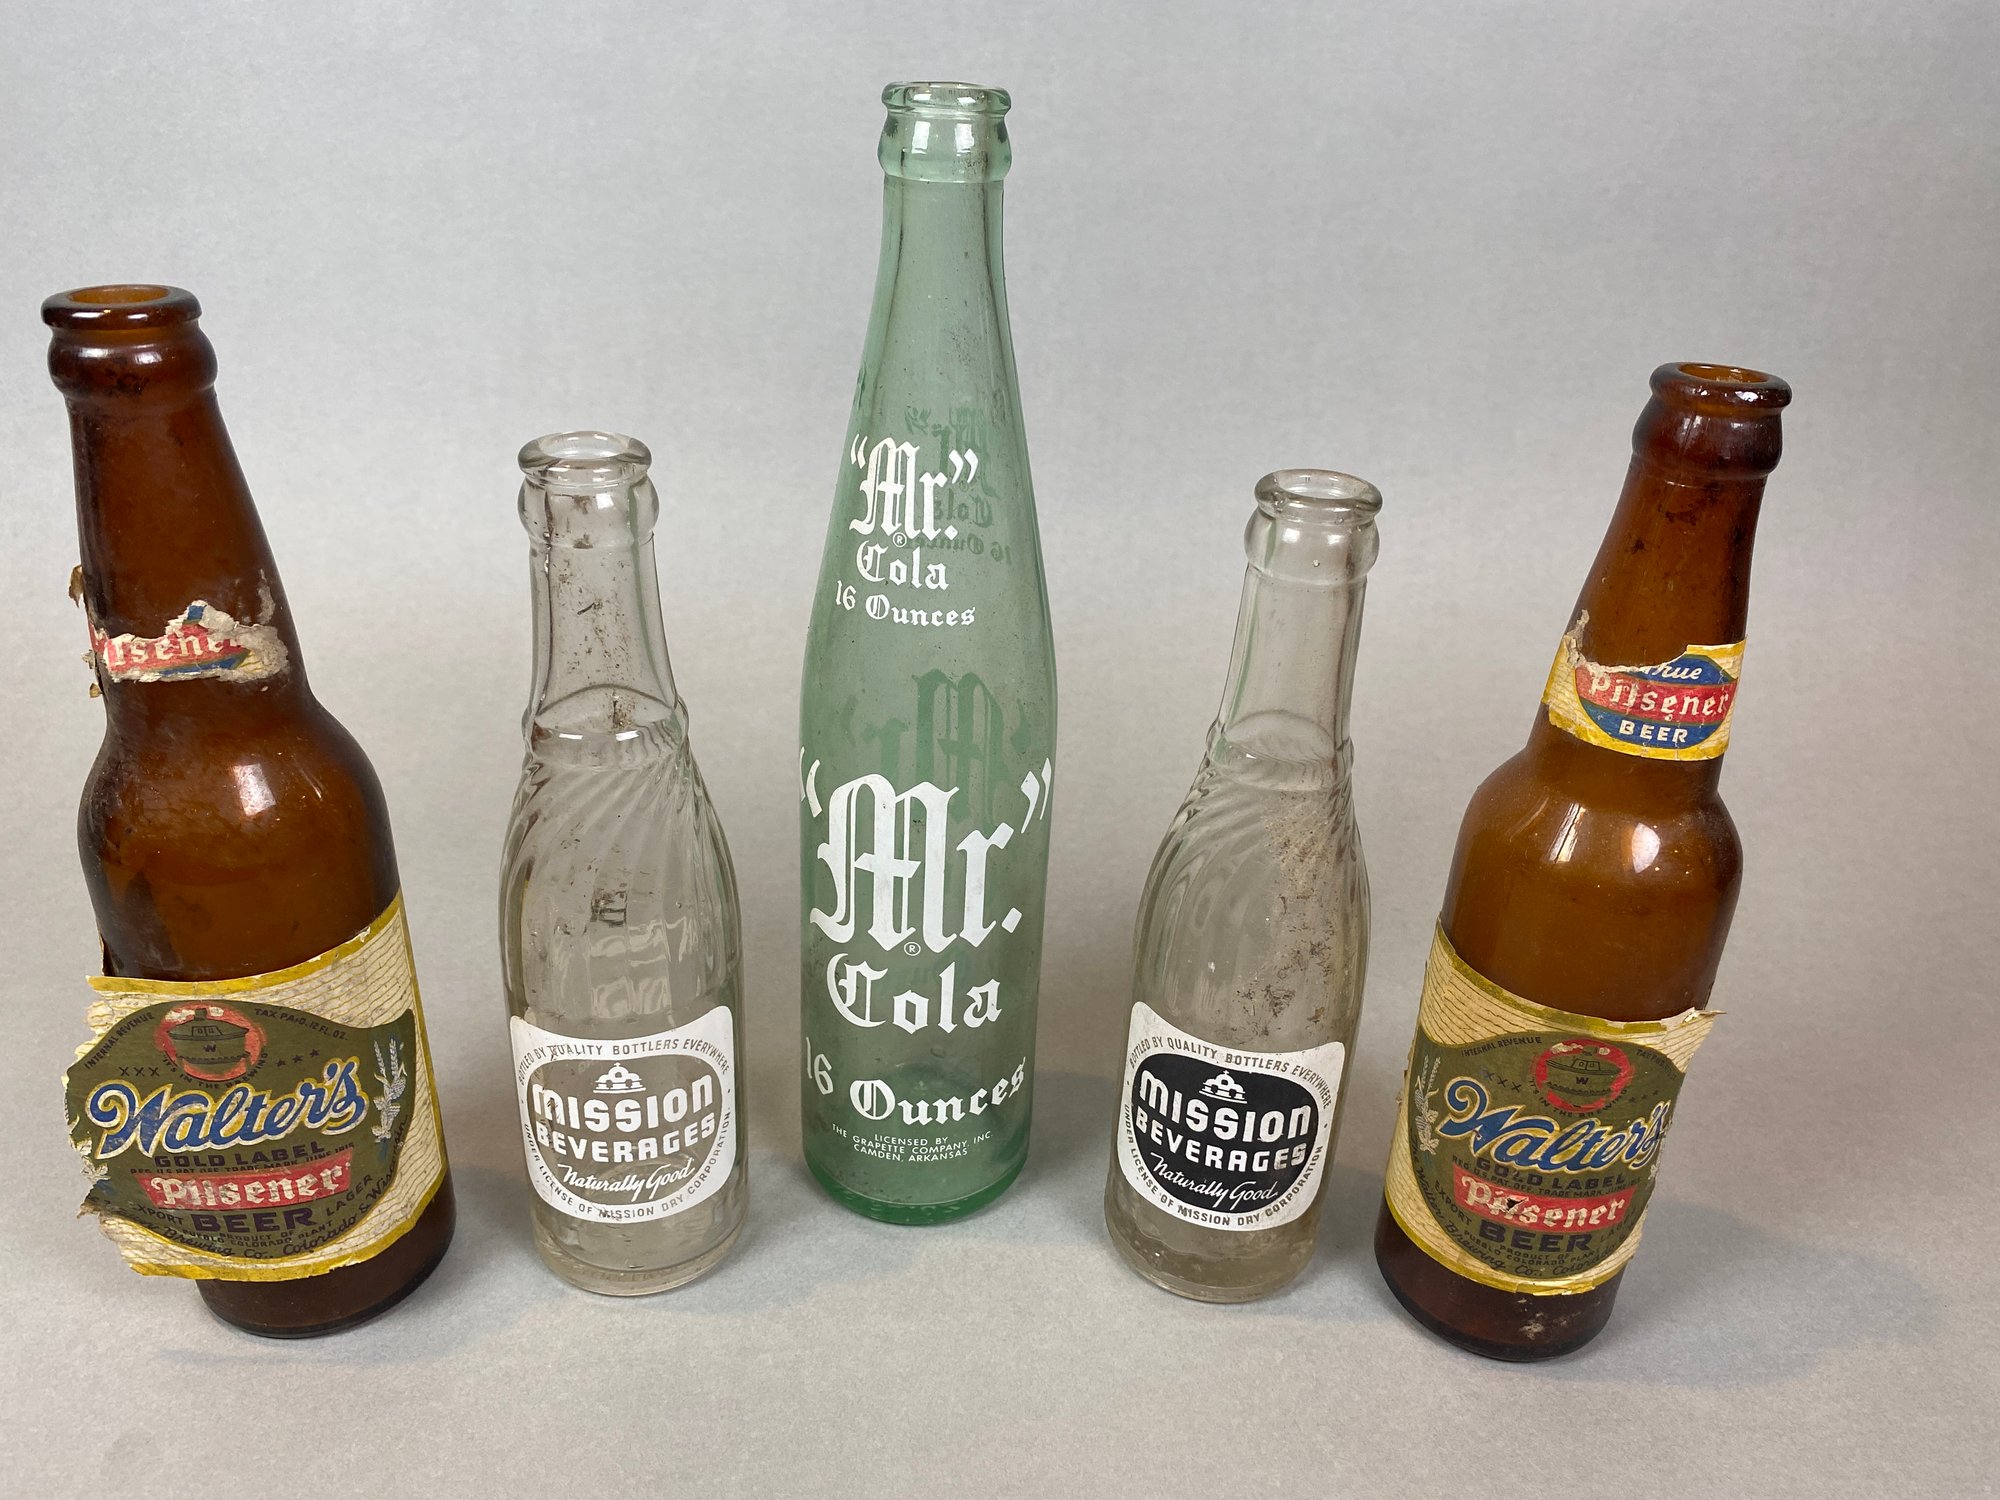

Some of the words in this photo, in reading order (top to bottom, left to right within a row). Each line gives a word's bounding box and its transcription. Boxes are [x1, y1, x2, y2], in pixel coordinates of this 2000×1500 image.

[856, 540, 949, 591] Cola
[835, 580, 857, 611] 16
[865, 594, 976, 627] Ounces
[1588, 670, 1728, 717] Pilsener
[1618, 719, 1688, 744] BEER
[254, 1008, 277, 1020] TAX
[826, 953, 1002, 1035] Cola
[83, 1031, 119, 1070] INTERNAL
[116, 1012, 155, 1037] REVENUE
[533, 1046, 547, 1060] BY
[612, 1039, 679, 1056] BOTTLERS
[682, 1038, 730, 1076] EVERYWHERE
[1461, 1043, 1496, 1057] INTERNAL
[1498, 1036, 1542, 1049] REVENUE
[805, 1036, 834, 1095] 16
[849, 1056, 1027, 1126] Ounces
[1130, 1038, 1151, 1069] BOTTLED
[1152, 1036, 1164, 1048] BY
[1167, 1037, 1217, 1060] QUALITY
[1225, 1053, 1290, 1073] BOTTLERS
[1291, 1065, 1333, 1109] EVERYWHERE
[85, 1055, 370, 1159] Walter's
[154, 1153, 226, 1168] GOLD
[235, 1140, 325, 1165] LABEL
[535, 1112, 716, 1163] BEVERAGES
[832, 1123, 848, 1138] THE
[852, 1135, 905, 1154] GRAPETTE
[973, 1130, 993, 1144] INC.
[874, 1134, 928, 1146] LICENSED
[935, 1136, 948, 1145] BY
[908, 1148, 968, 1162] ARKANSAS
[1136, 1103, 1307, 1173] BEVERAGES
[151, 1163, 345, 1207] Pilsener
[524, 1123, 540, 1162] UNDER
[539, 1164, 574, 1206] LICENSE
[578, 1203, 593, 1213] OF
[598, 1206, 655, 1220] MISSION
[662, 1195, 684, 1213] DRY
[557, 1163, 647, 1203] Naturally
[646, 1158, 696, 1200] Good
[1124, 1103, 1134, 1144] UNDER
[1130, 1148, 1158, 1195] LICENSE
[1160, 1194, 1174, 1208] OF
[1177, 1205, 1231, 1226] MISSION
[1237, 1214, 1261, 1226] DRY
[1265, 1145, 1323, 1217] CORPORATION
[1150, 1152, 1230, 1209] Naturally
[1229, 1181, 1279, 1210] Good
[1475, 1157, 1543, 1186] GOLD
[1552, 1173, 1625, 1191] LABEL
[132, 1203, 184, 1225] XPORT
[190, 1207, 317, 1233] BEER
[326, 1174, 373, 1216] LAGER
[1435, 1180, 1472, 1225] EXPORT
[1479, 1219, 1592, 1252] BEER
[1539, 1188, 1570, 1198] TRADE
[282, 1216, 357, 1256] Colorado
[1445, 1220, 1506, 1270] Brewing
[1464, 1230, 1501, 1256] PUEBLO
[1506, 1254, 1565, 1265] COLORADO
[1500, 1245, 1550, 1260] PRODUCT
